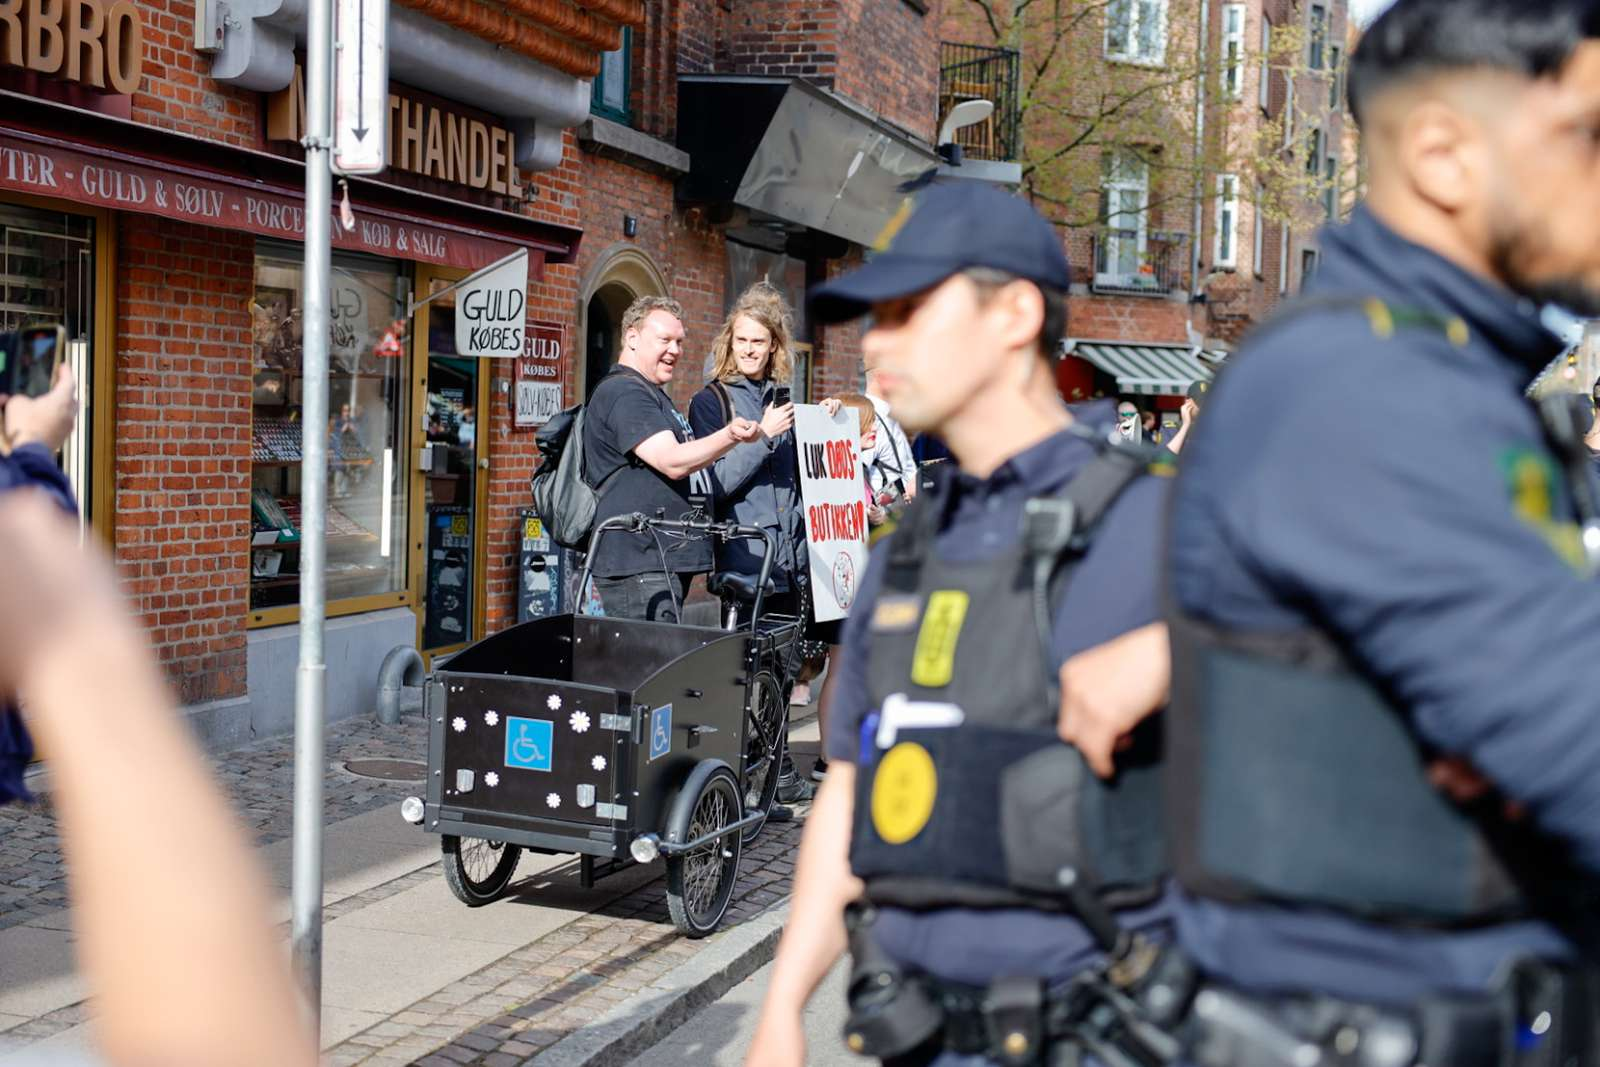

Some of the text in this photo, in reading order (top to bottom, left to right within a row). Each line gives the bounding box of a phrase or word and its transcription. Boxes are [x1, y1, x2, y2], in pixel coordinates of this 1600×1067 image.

[0, 147, 57, 187] TER
[81, 165, 147, 204] GULD
[155, 179, 168, 209] &
[175, 183, 224, 218] SØLV
[361, 219, 391, 249] KØB
[396, 227, 409, 252] &
[412, 228, 446, 258] SALG
[463, 288, 524, 322] GULD
[469, 327, 521, 352] KØBES
[523, 336, 560, 360] GULD
[524, 363, 556, 377] KØBES
[804, 441, 827, 480] LUK
